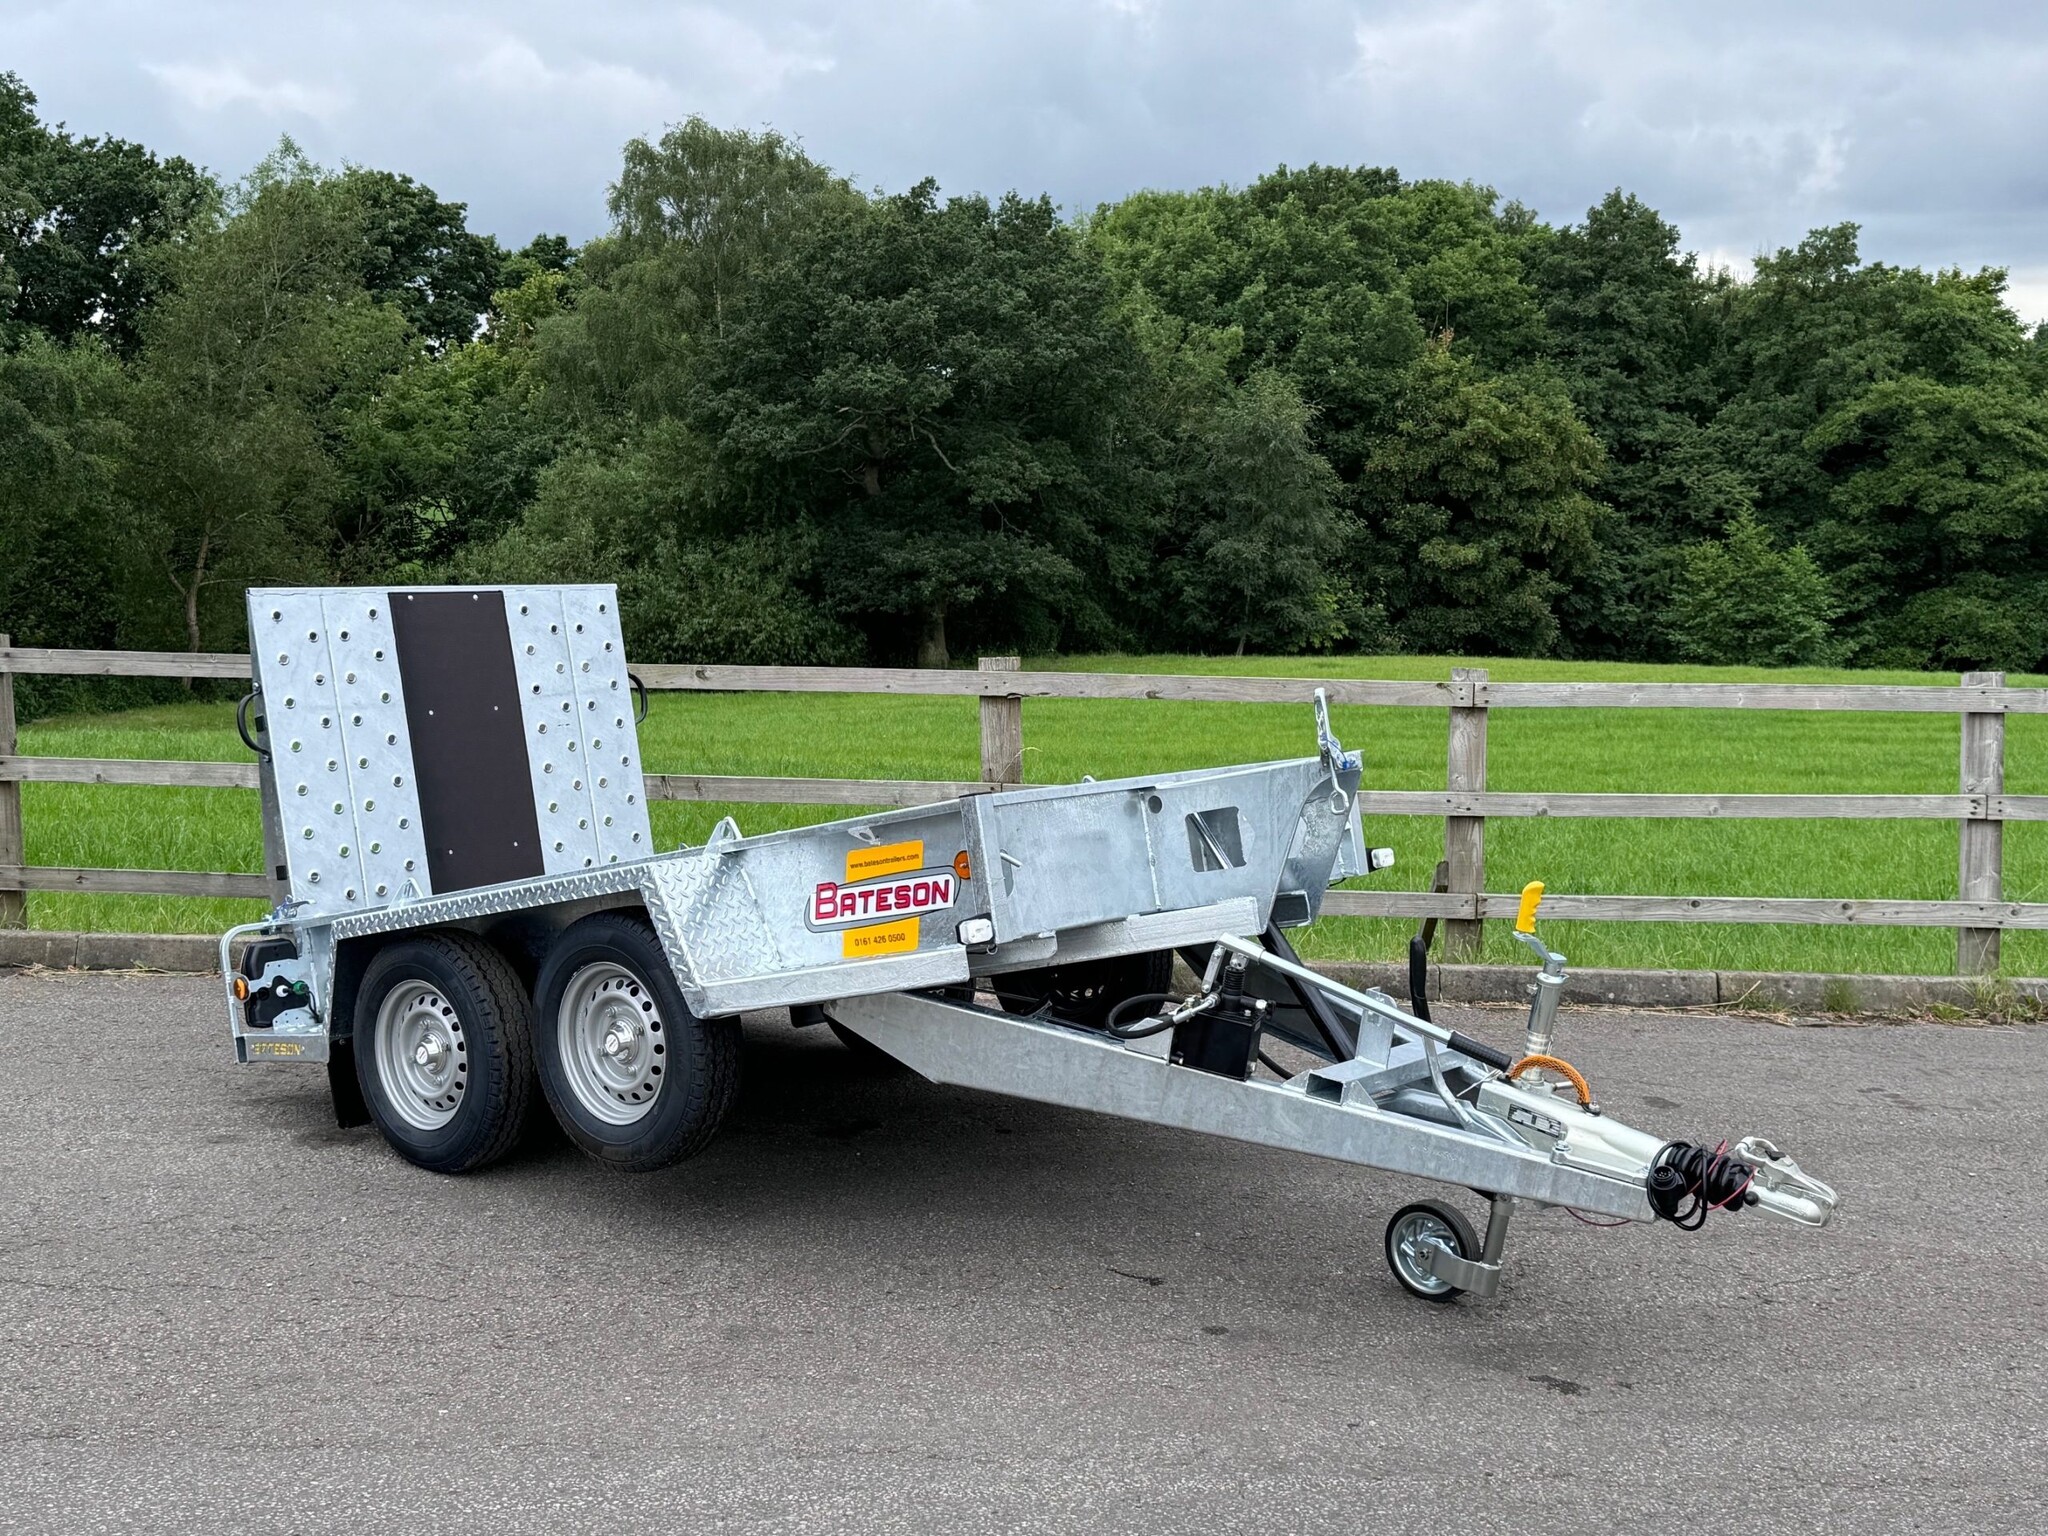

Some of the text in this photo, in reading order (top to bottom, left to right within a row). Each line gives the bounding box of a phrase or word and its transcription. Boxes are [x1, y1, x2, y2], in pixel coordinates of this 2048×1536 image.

[849, 853, 920, 870] www.batesontrailers.com
[815, 878, 951, 921] BATESON
[854, 932, 906, 947] 0161 426 0500
